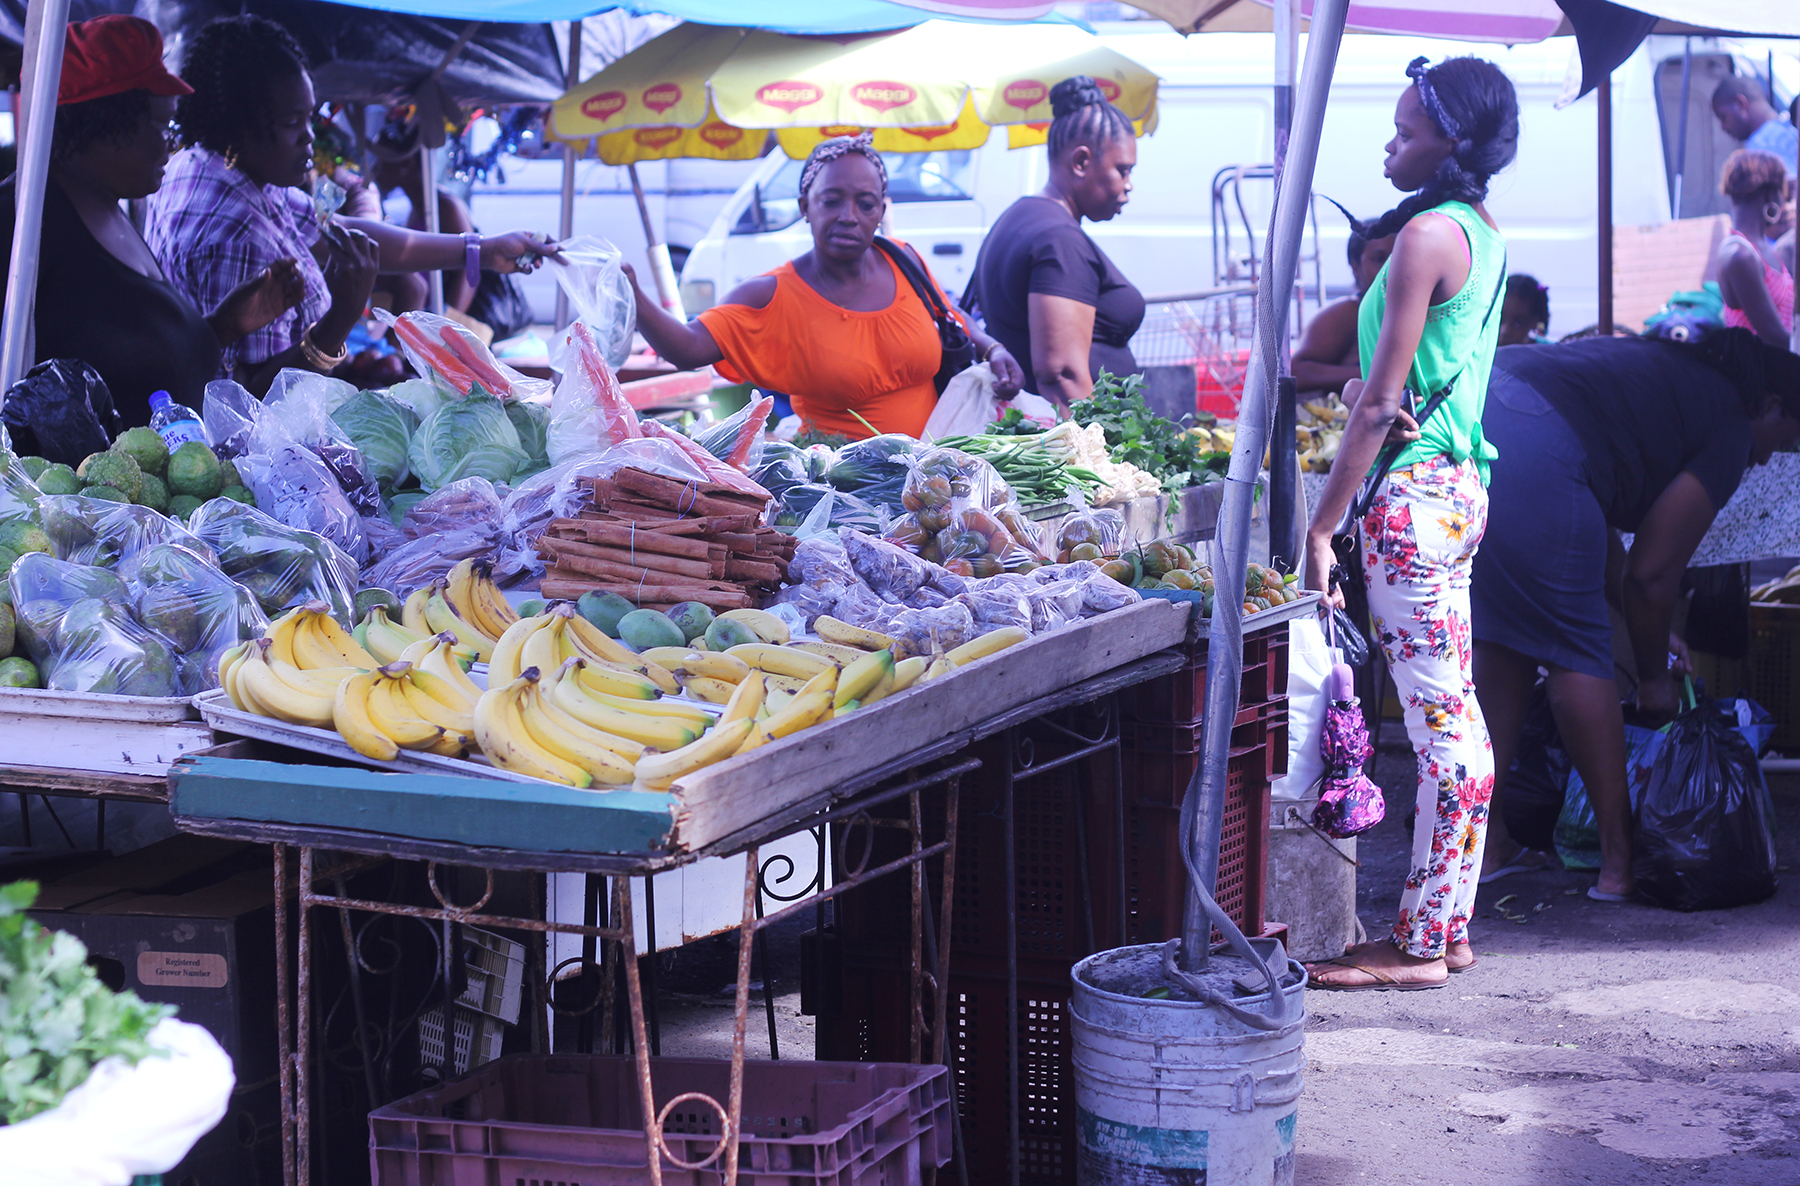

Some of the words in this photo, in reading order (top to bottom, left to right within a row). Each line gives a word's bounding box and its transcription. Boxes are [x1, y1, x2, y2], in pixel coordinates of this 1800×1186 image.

[762, 87, 817, 102] Maggi
[856, 87, 911, 102] Maggi
[1007, 87, 1043, 101] Maggi
[163, 431, 175, 442] ue
[167, 433, 189, 447] ERS
[165, 957, 201, 967] Registered
[155, 967, 182, 976] Grower
[183, 968, 211, 978] Number
